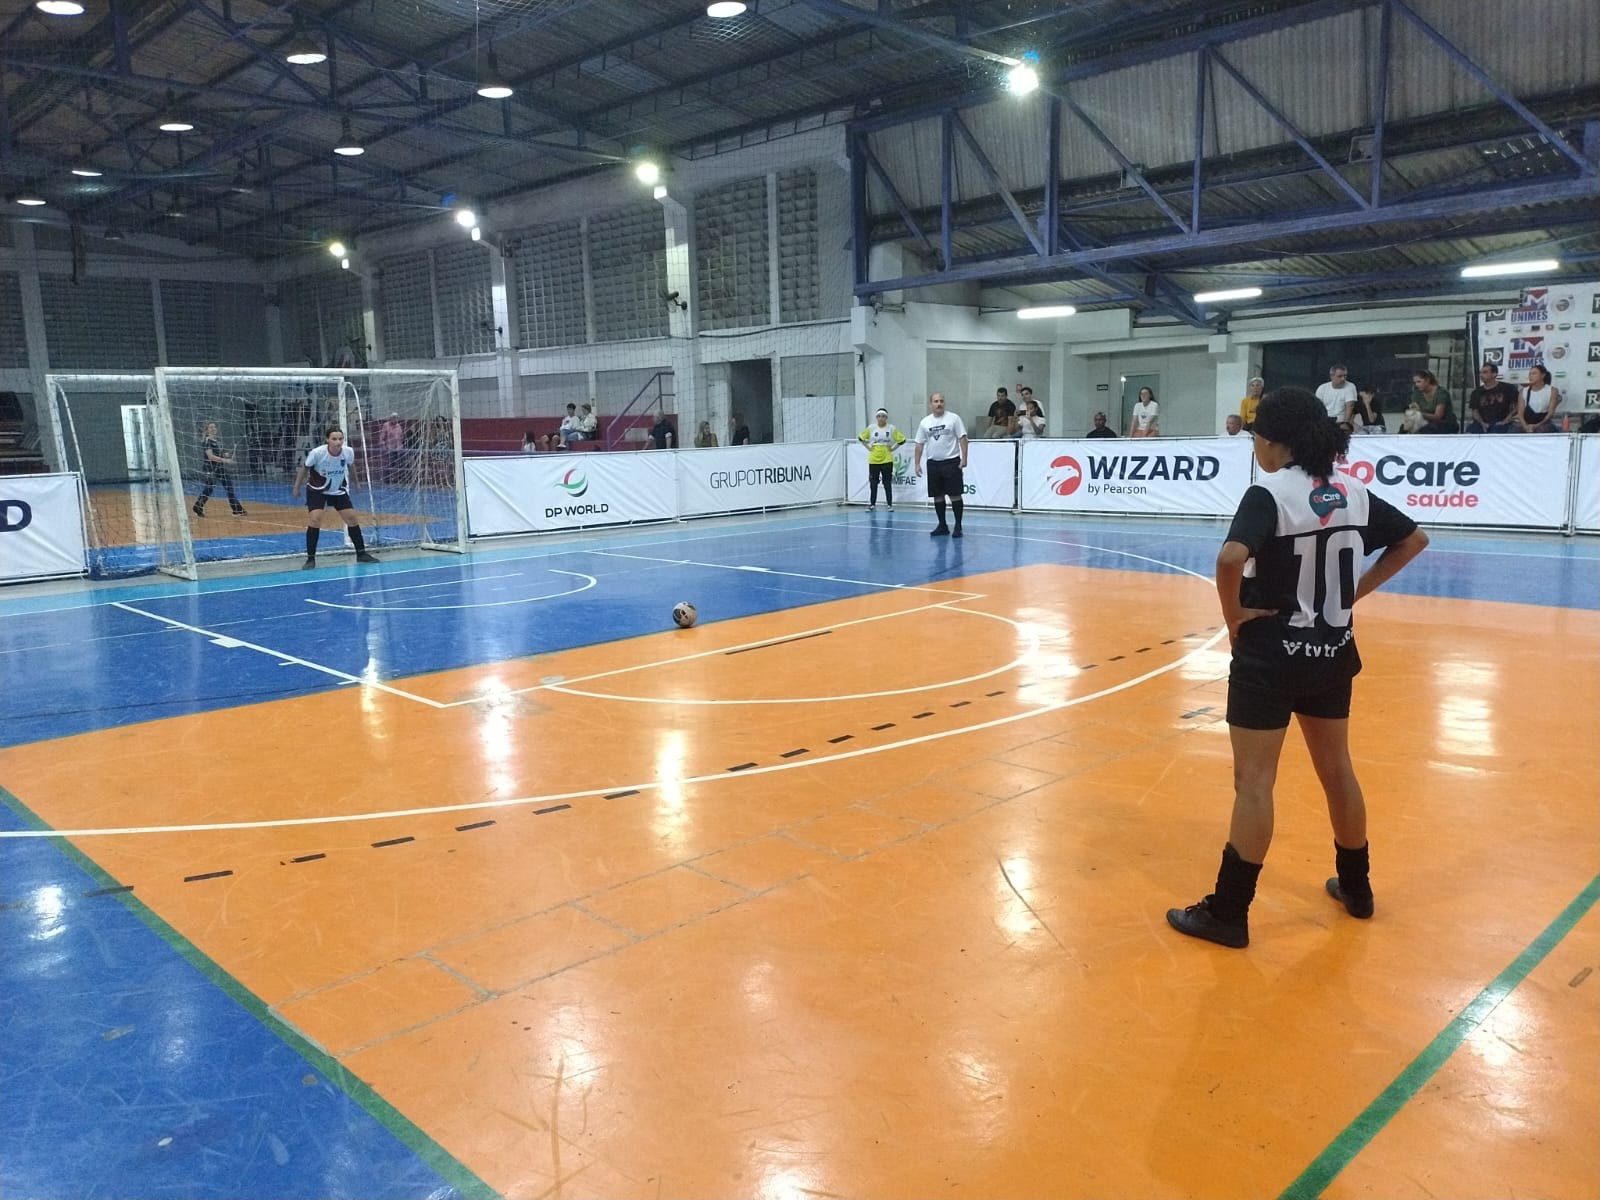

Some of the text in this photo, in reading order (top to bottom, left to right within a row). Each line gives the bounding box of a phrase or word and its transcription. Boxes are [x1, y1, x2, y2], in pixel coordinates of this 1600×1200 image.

[1511, 310, 1548, 323] UNIMES
[1087, 455, 1220, 481] WIZARD
[710, 465, 812, 489] GRUPOTRIBUNA
[1087, 483, 1147, 495] by Pearson
[1407, 489, 1479, 507] saúde
[545, 503, 609, 518] DP WORLD
[1288, 530, 1364, 628] 10
[1305, 643, 1321, 657] tv
